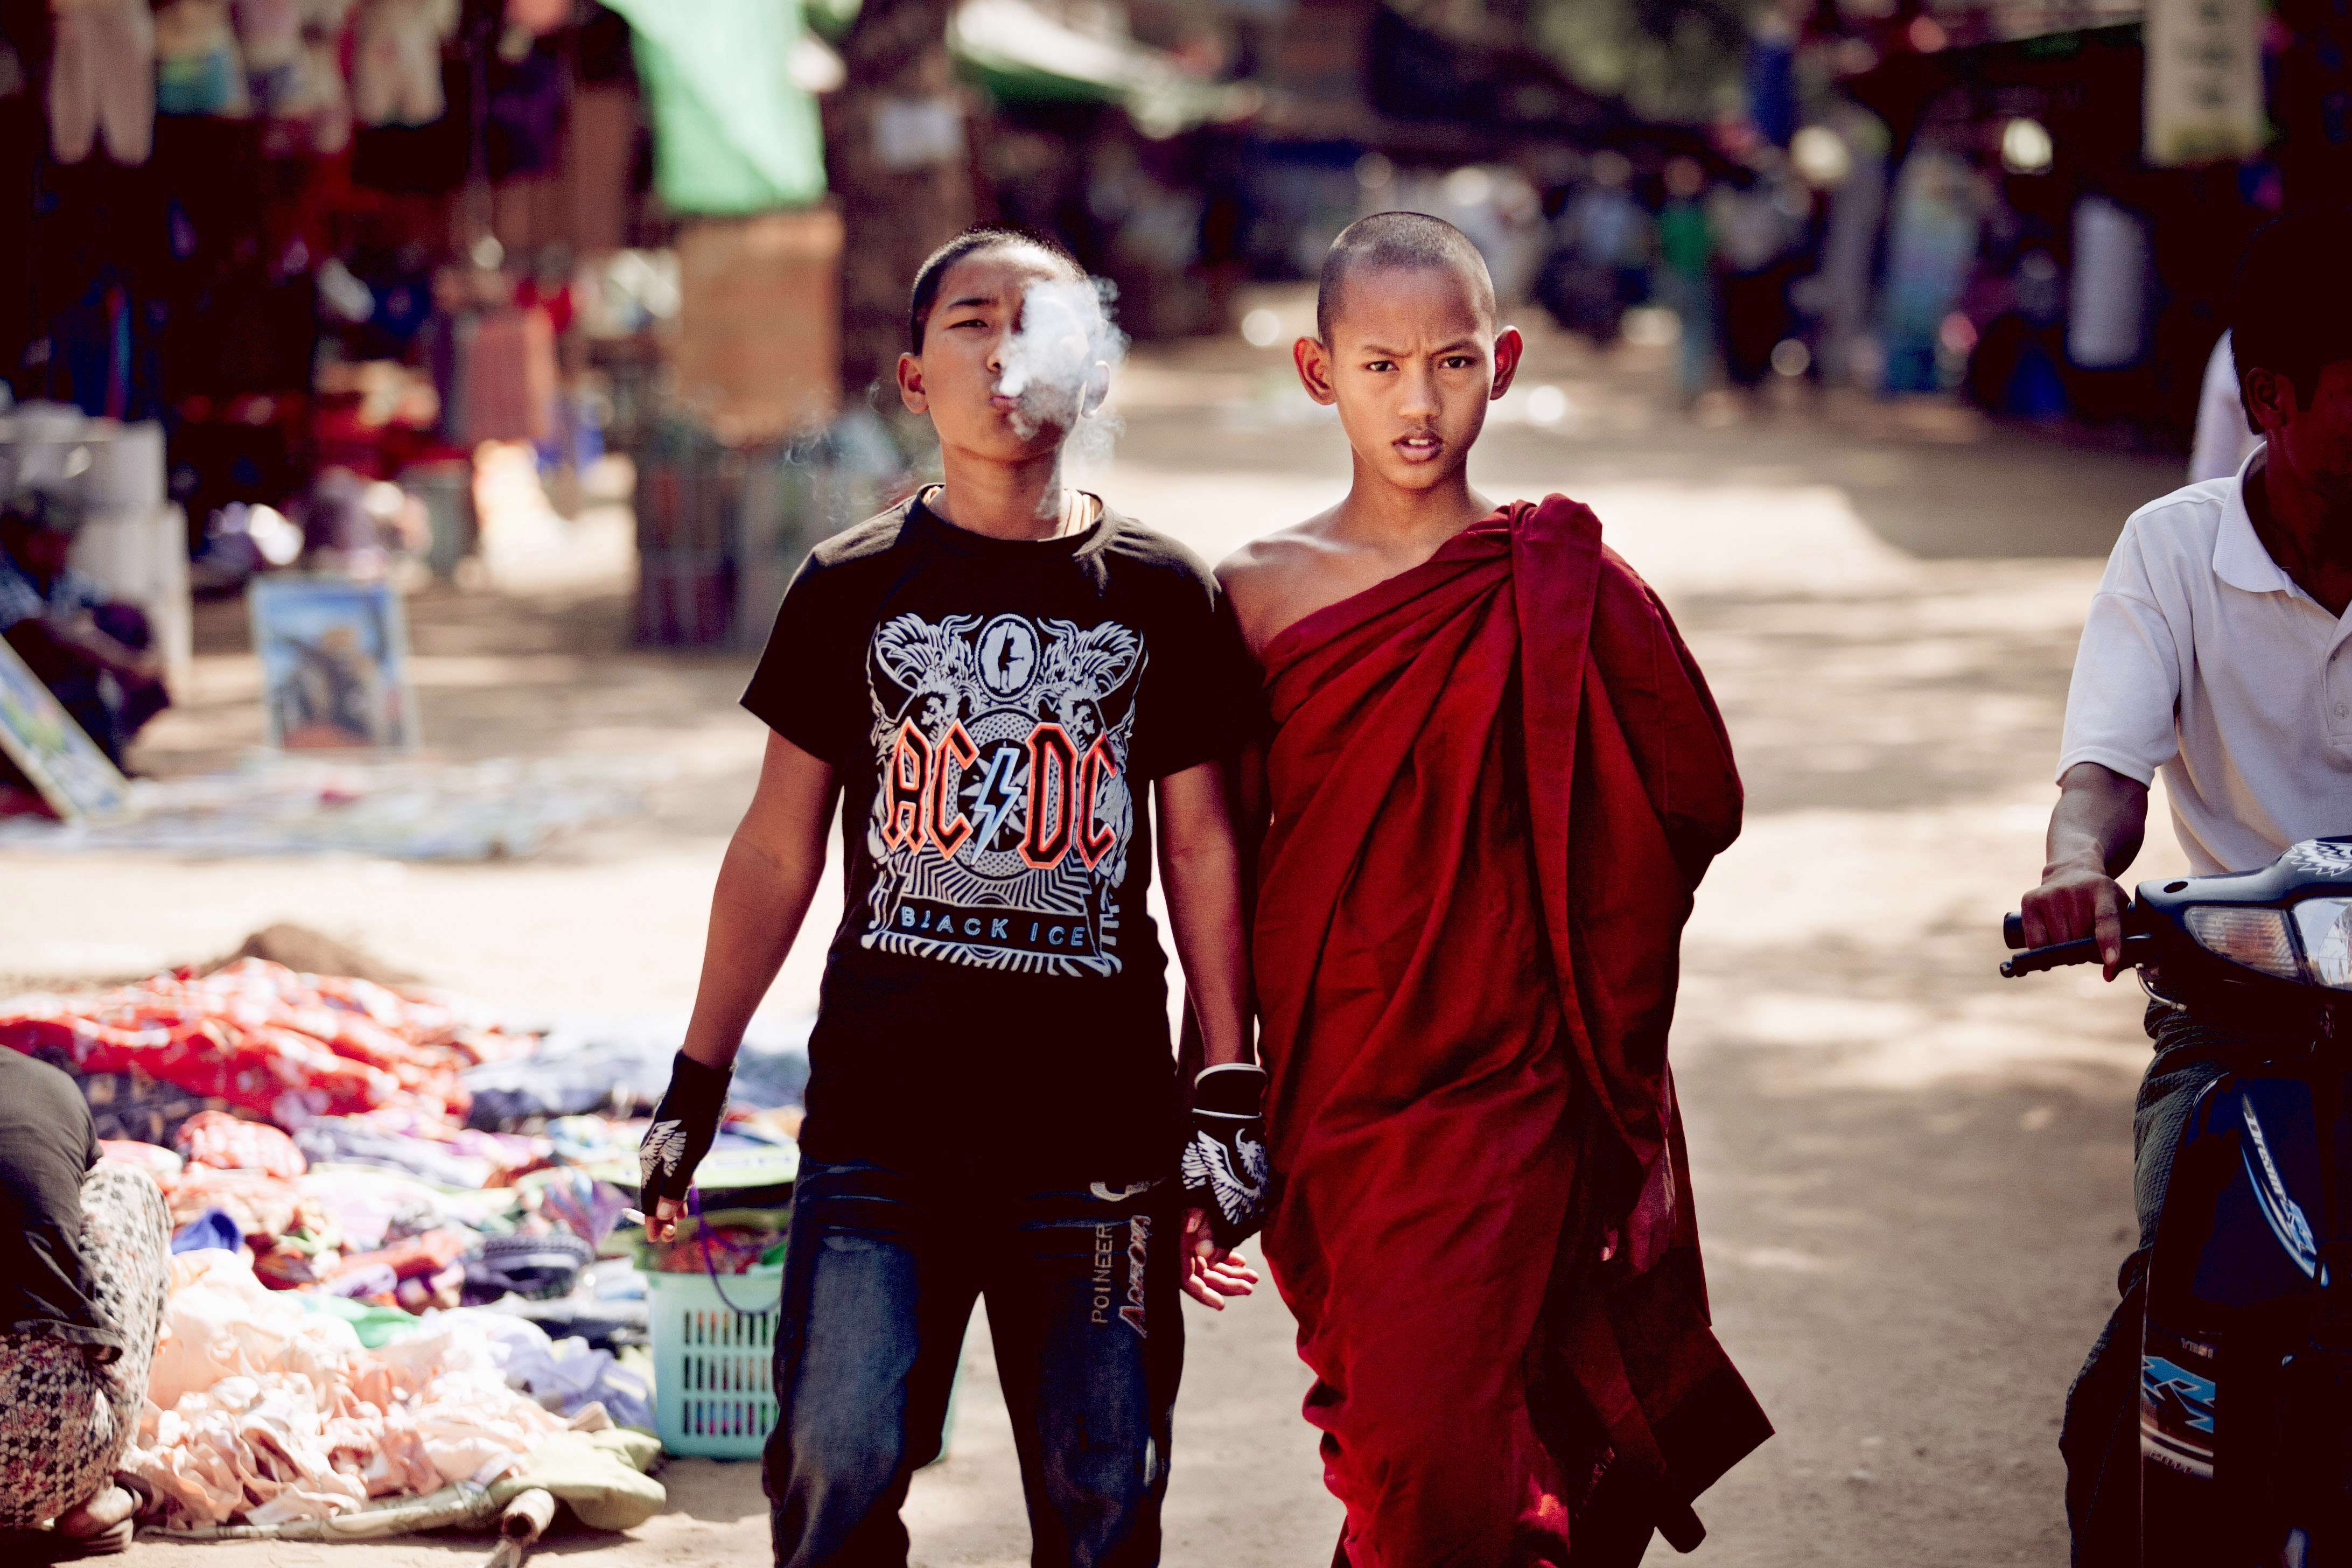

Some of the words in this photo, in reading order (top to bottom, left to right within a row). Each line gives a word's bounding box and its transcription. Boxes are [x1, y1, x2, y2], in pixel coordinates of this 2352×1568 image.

[901, 906, 1009, 939] BLACK
[1030, 922, 1086, 947] ICE
[1091, 1223, 1113, 1324] POINEER
